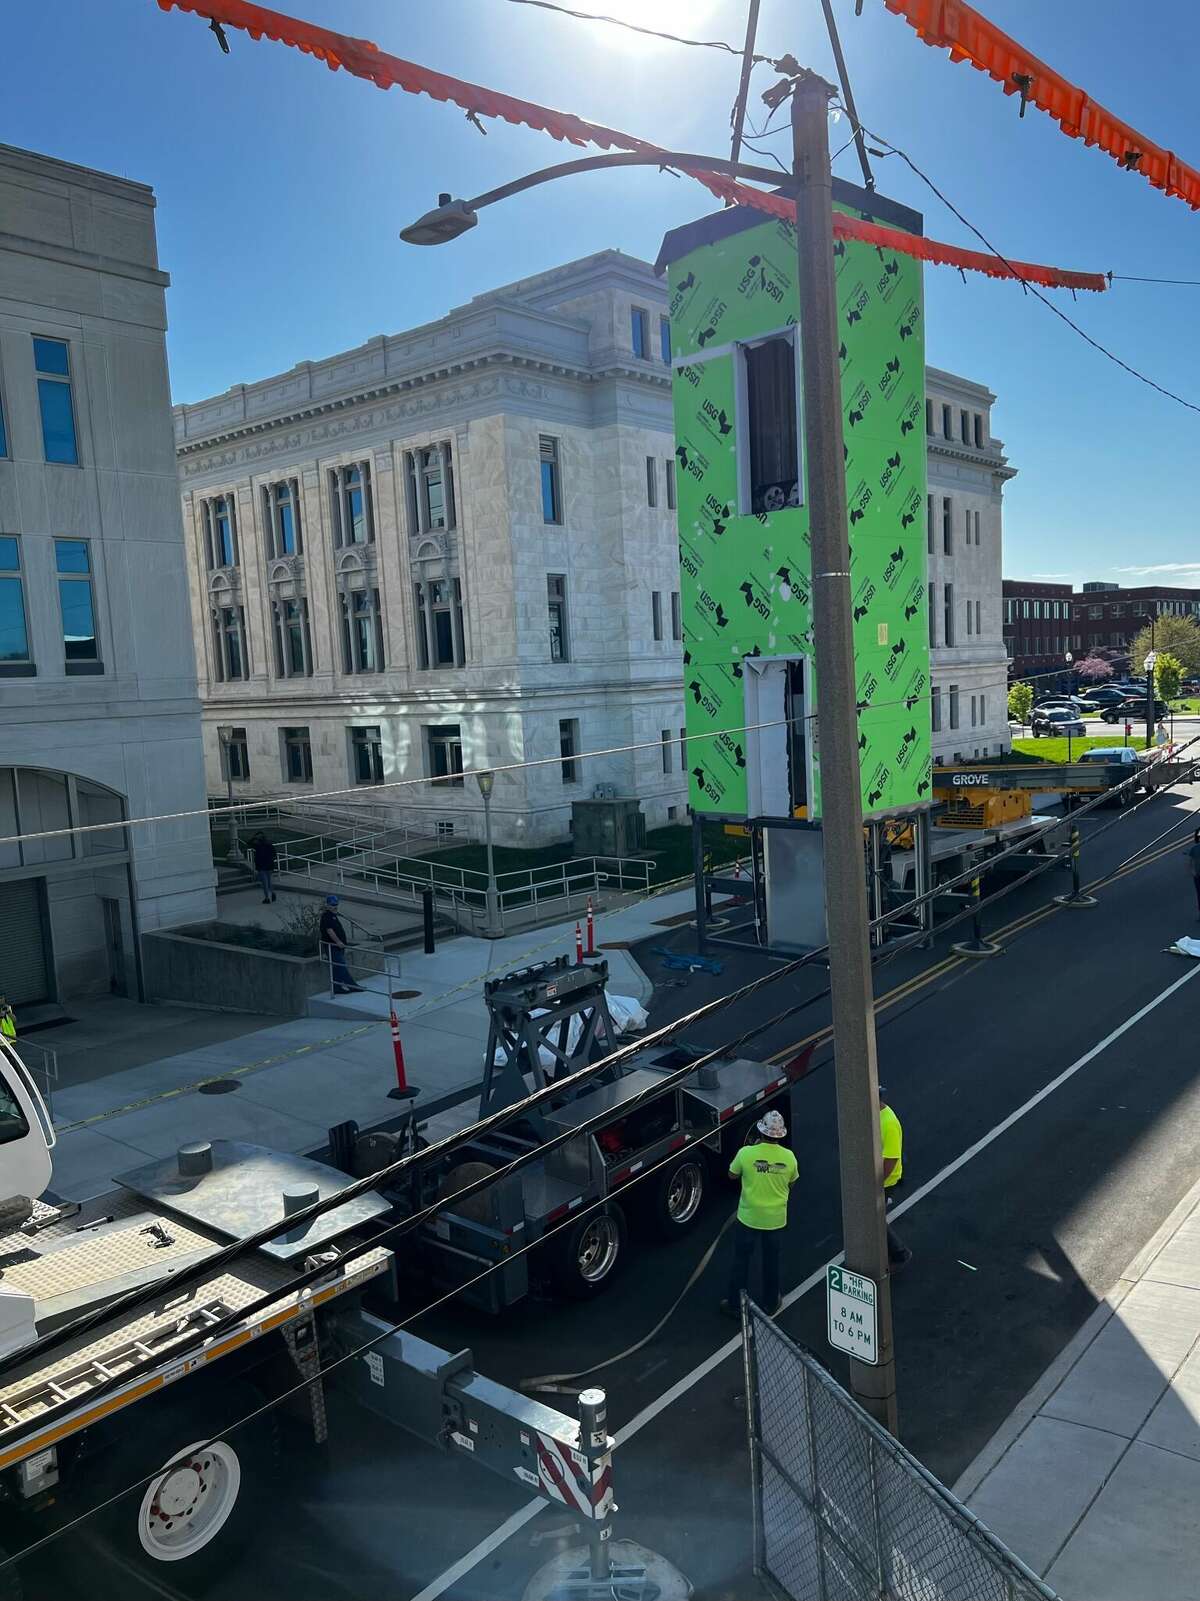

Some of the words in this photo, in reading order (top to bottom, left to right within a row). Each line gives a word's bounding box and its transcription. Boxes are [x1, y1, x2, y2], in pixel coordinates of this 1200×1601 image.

[738, 268, 755, 293] USG
[878, 273, 889, 294] USG
[766, 281, 784, 303] USG
[858, 292, 870, 312] USG
[711, 302, 727, 326] USG
[908, 308, 920, 326] USG
[684, 367, 700, 388] USG
[879, 371, 891, 392] USG
[703, 400, 718, 420] USG
[859, 392, 871, 411] USG
[910, 402, 921, 421] USG
[688, 462, 704, 482] USG
[880, 468, 892, 488] USG
[706, 494, 721, 515] USG
[860, 488, 872, 509] USG
[911, 494, 921, 513] USG
[682, 558, 698, 578] USG
[883, 562, 895, 582] USG
[700, 591, 716, 611] USG
[791, 583, 809, 606] USG
[863, 585, 876, 606] USG
[913, 586, 924, 606] USG
[752, 599, 770, 620] USG
[884, 654, 896, 674] USG
[865, 678, 877, 699] USG
[914, 675, 926, 695] USG
[702, 696, 717, 718] USG
[896, 743, 908, 764] USG
[878, 768, 889, 789] USG
[952, 774, 988, 785] GROVE
[705, 784, 720, 804] USG
[830, 1270, 840, 1288] 2
[852, 1278, 863, 1289] HR
[844, 1284, 872, 1303] PARKING
[841, 1307, 846, 1317] 8
[850, 1312, 862, 1325] AM
[834, 1320, 844, 1332] TO
[848, 1326, 853, 1336] 6
[858, 1330, 870, 1344] PM
